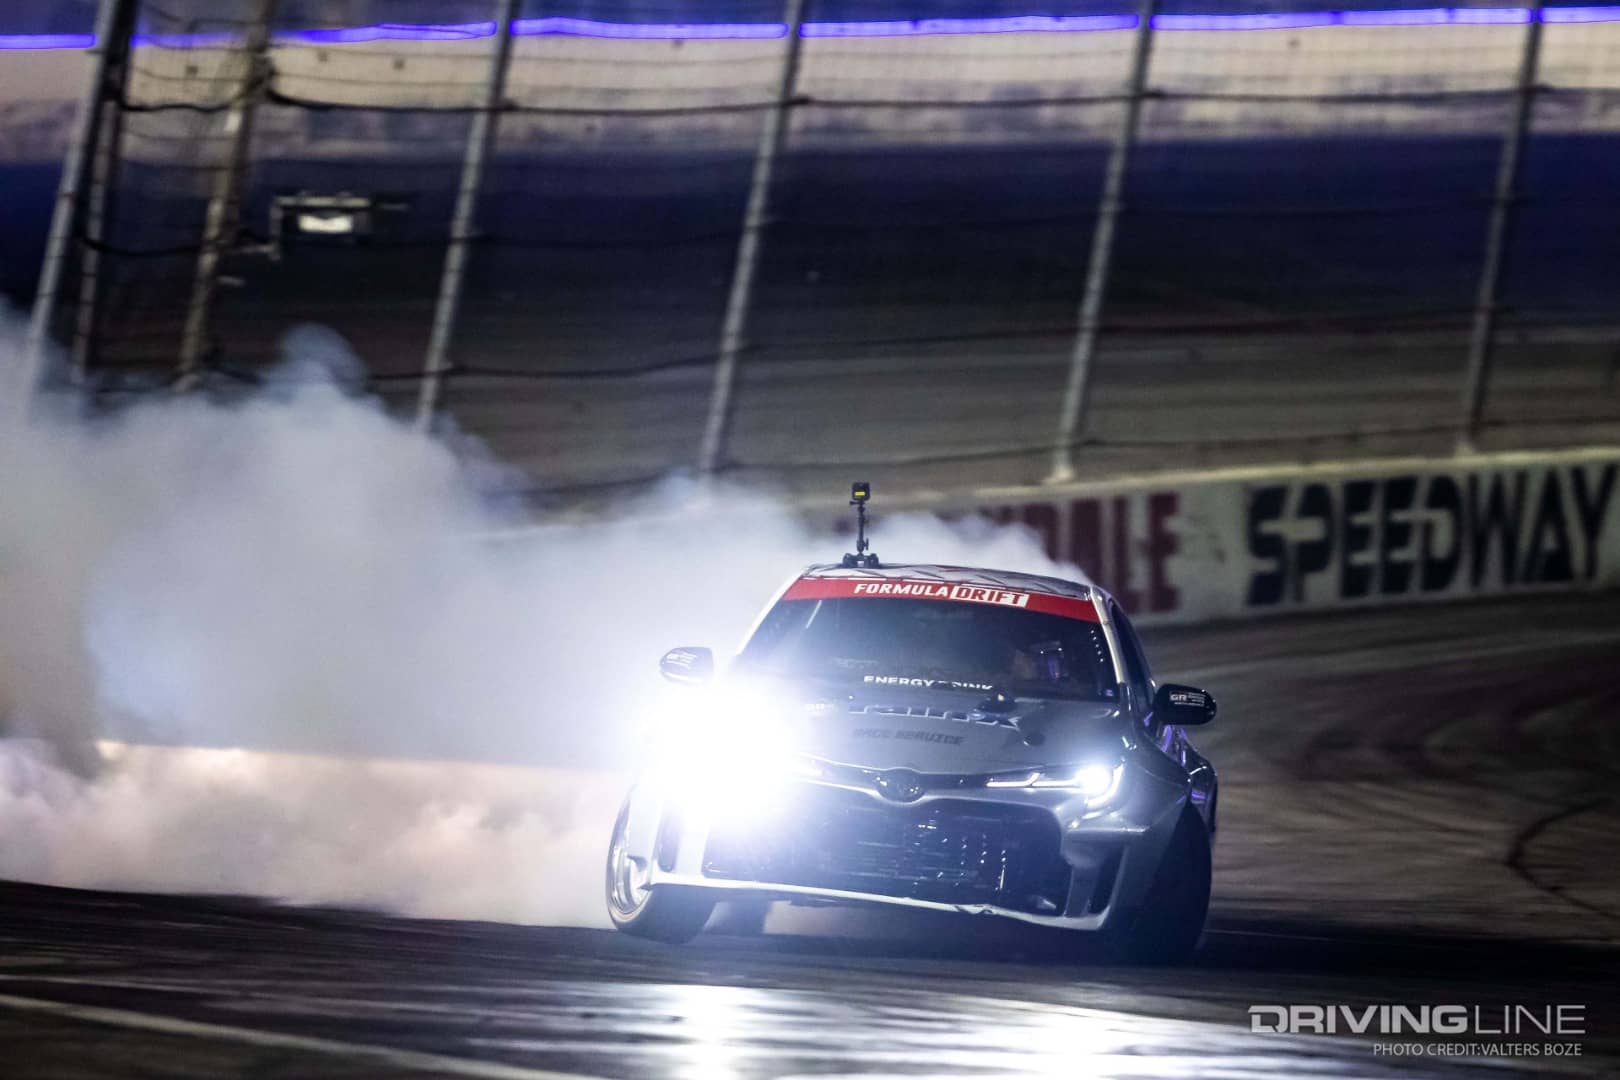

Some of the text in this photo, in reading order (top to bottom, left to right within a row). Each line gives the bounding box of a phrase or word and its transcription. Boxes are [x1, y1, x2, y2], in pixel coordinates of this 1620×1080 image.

[1244, 462, 1619, 606] SPEEDWAY
[854, 583, 1026, 606] FORMULA DRIFT
[863, 675, 935, 687] ENERGY
[1170, 694, 1187, 702] GR
